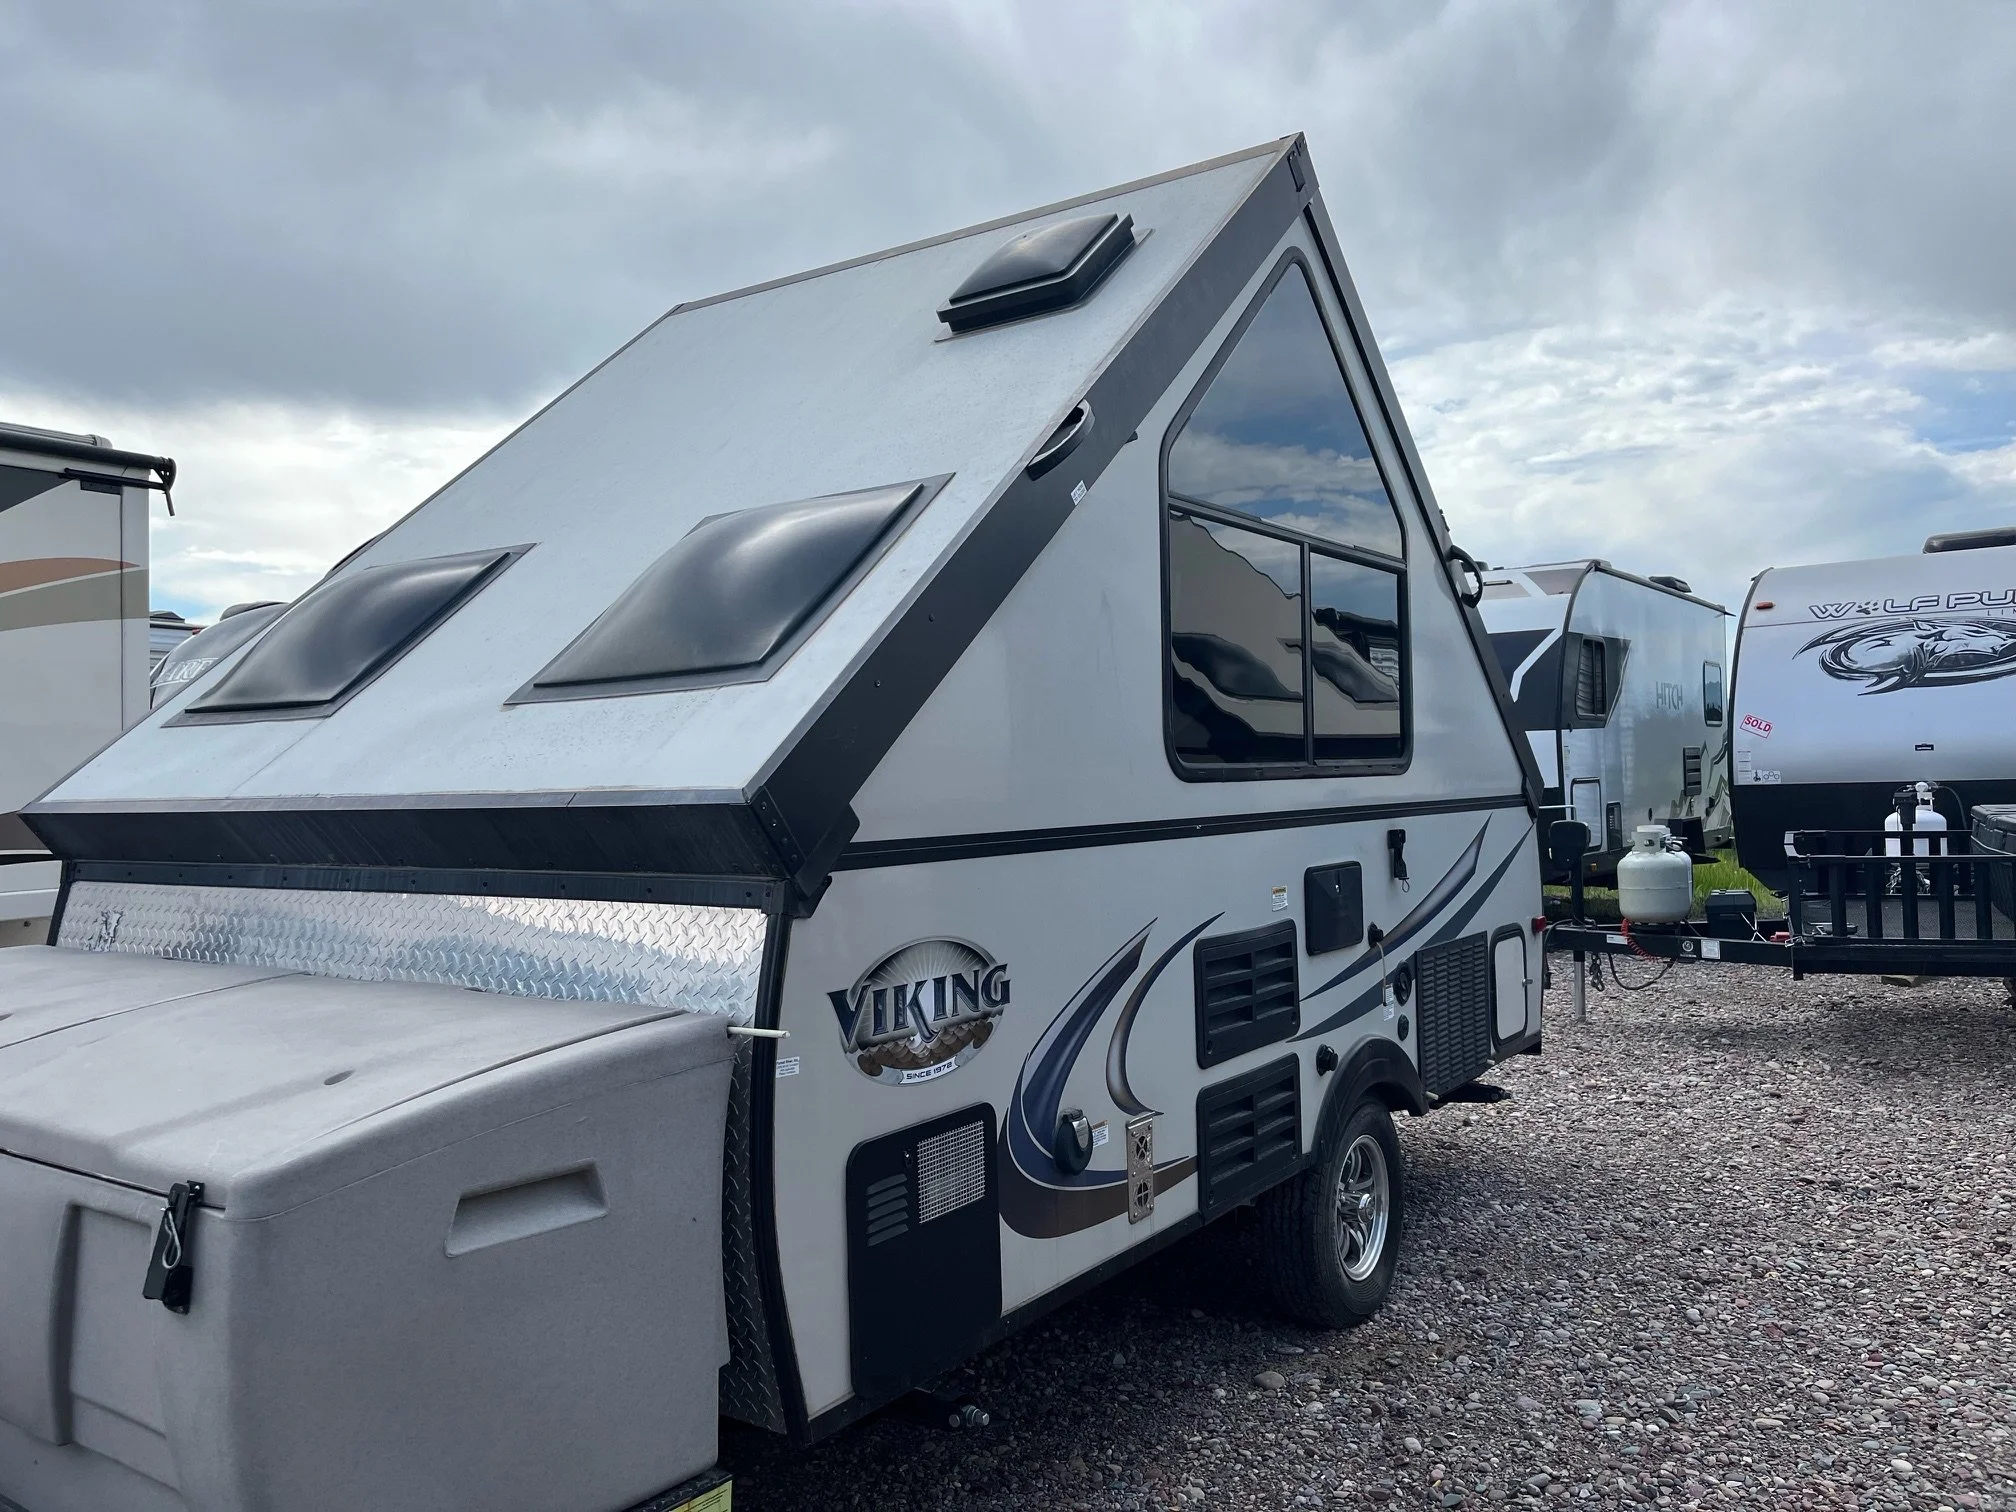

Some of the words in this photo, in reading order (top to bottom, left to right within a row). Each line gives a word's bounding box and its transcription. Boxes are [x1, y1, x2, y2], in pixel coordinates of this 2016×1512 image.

[1946, 589, 2016, 609] PU
[1655, 681, 1683, 710] HITCH
[1744, 716, 1771, 732] SOLD
[827, 963, 1011, 1048] VIKING
[906, 1070, 932, 1080] SINCE
